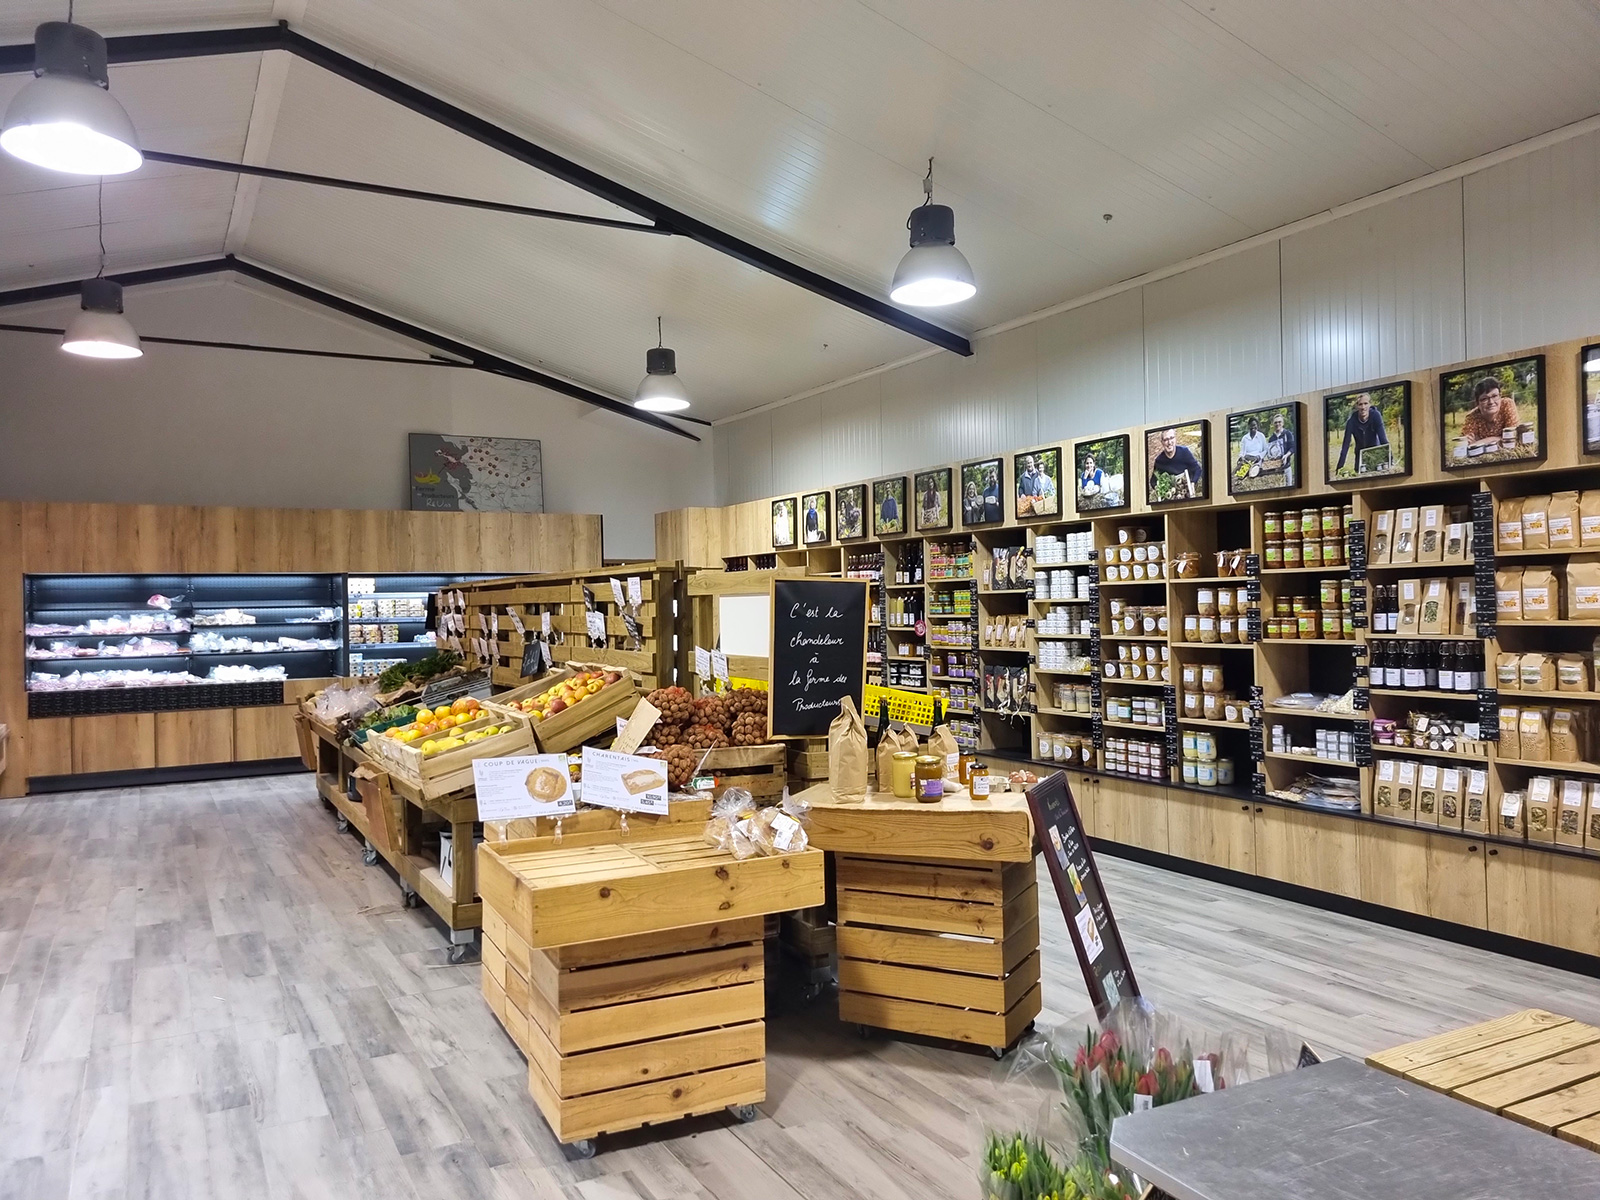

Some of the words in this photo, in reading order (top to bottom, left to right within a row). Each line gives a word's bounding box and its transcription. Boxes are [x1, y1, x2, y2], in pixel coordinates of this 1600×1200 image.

[790, 602, 819, 618] C'est
[825, 606, 844, 618] la
[789, 631, 844, 647] chandeleur
[788, 671, 801, 686] la
[803, 668, 830, 692] ferme
[484, 760, 504, 768] COUP
[518, 758, 539, 766] VAGUE
[592, 751, 630, 762] CHARENTAIS
